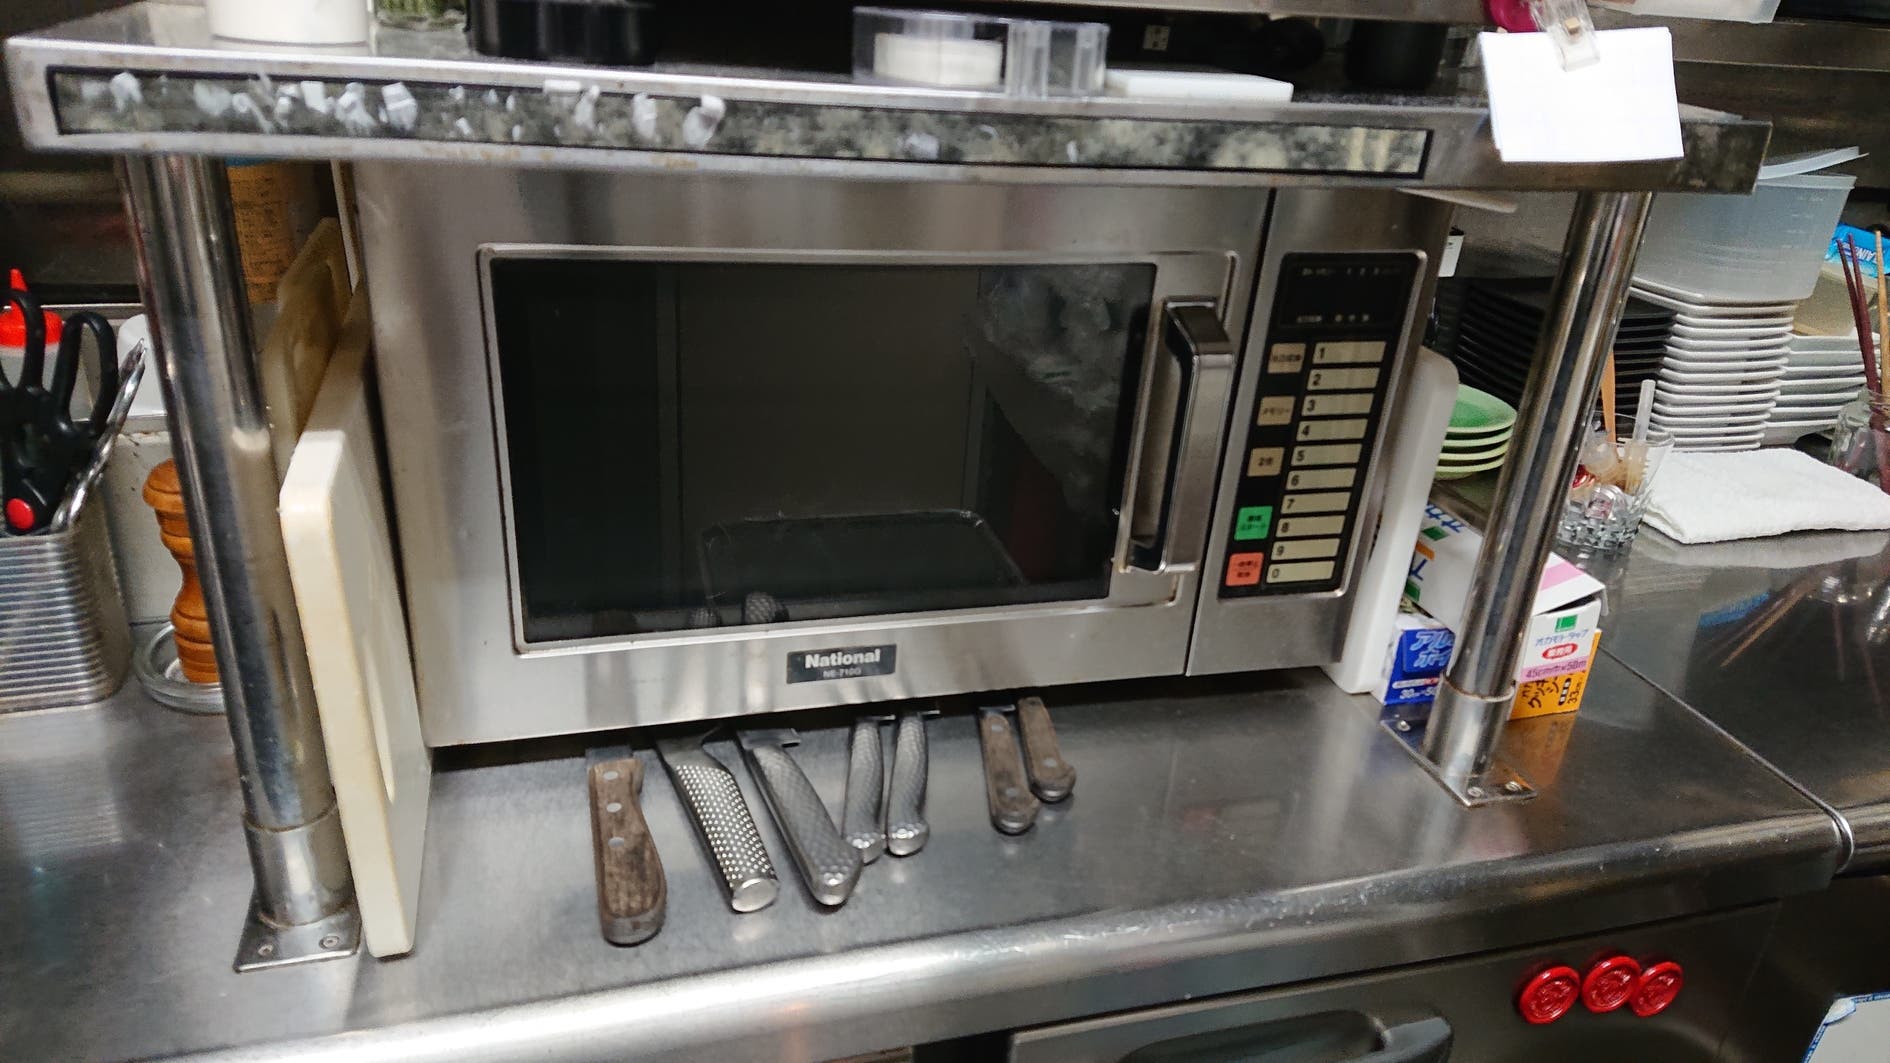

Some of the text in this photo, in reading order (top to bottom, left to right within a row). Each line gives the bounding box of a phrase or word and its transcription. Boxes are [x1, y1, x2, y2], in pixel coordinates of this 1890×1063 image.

[1319, 347, 1325, 359] 1
[1312, 374, 1321, 386] 2
[1307, 399, 1315, 412] 3
[1301, 425, 1310, 437] 4
[1296, 450, 1305, 462] 5
[1291, 475, 1300, 487] 6
[1286, 499, 1295, 510] 7
[1281, 522, 1290, 533] 8
[1276, 545, 1285, 556] 9
[1271, 568, 1280, 579] 0
[1409, 631, 1455, 651] アル
[805, 648, 881, 669] National
